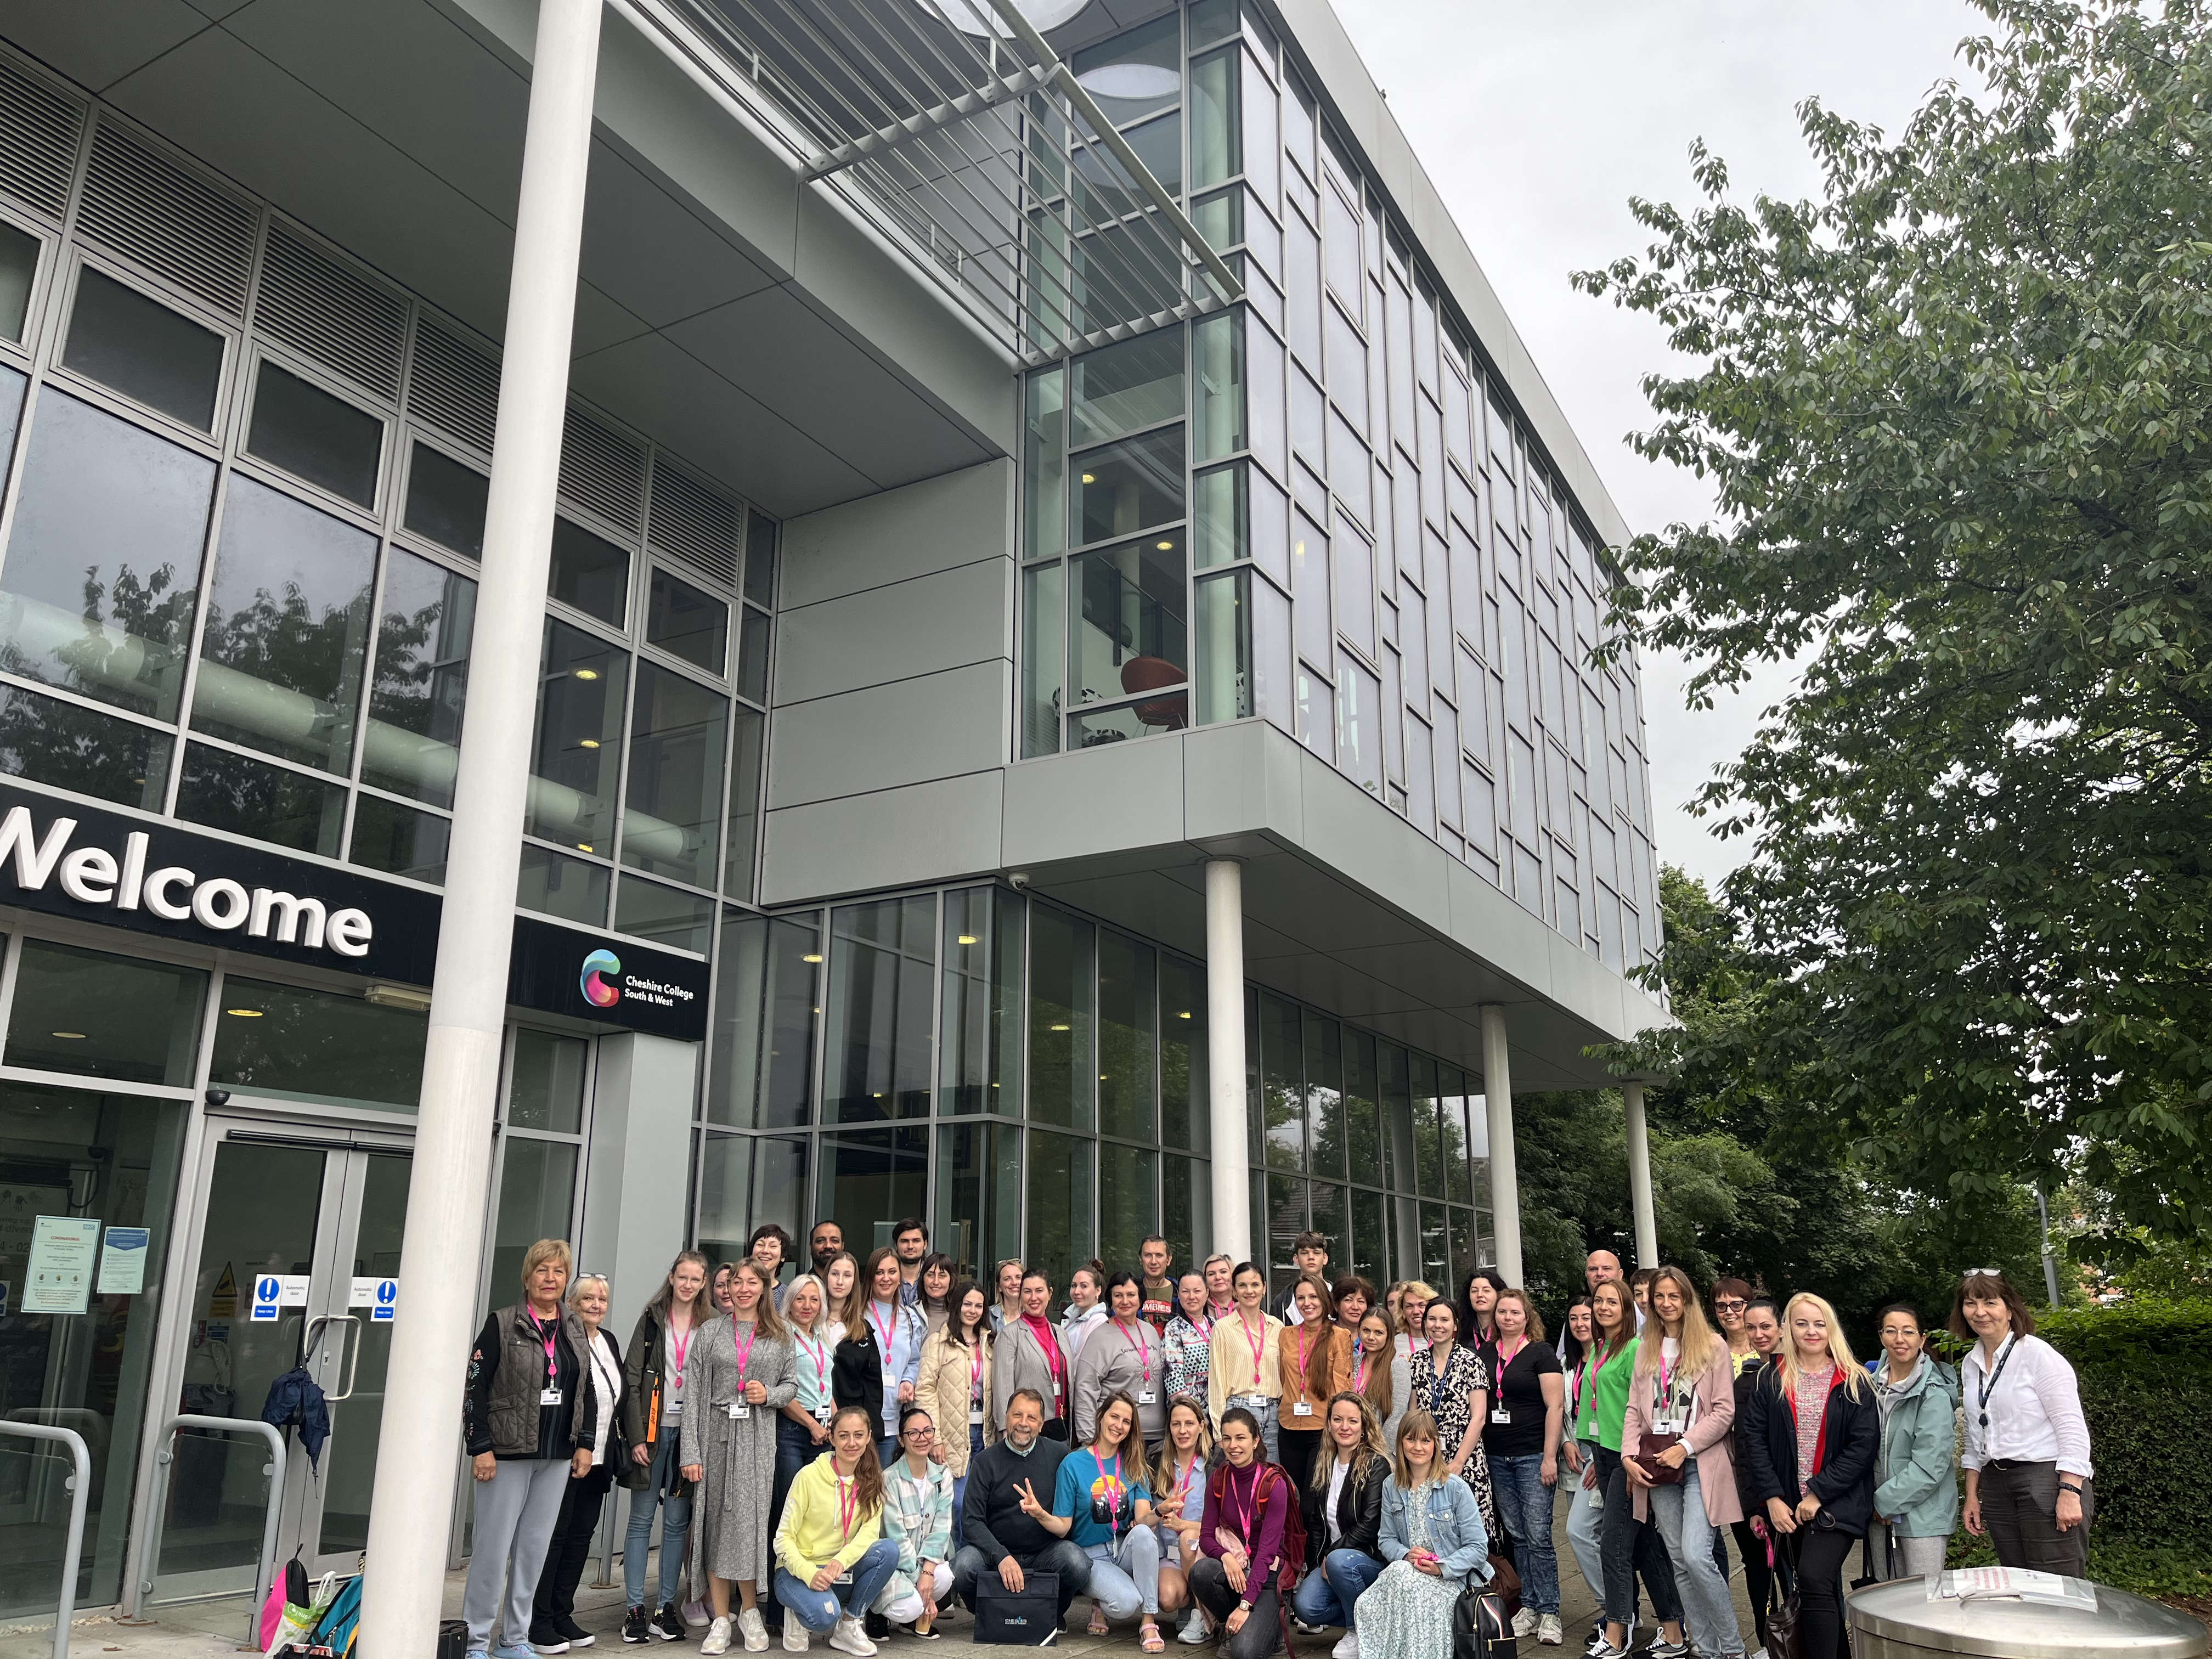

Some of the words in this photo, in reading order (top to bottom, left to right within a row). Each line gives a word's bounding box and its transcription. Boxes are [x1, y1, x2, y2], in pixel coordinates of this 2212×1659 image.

[0, 806, 372, 956] Welcome
[625, 975, 662, 992] Cheshire
[664, 984, 693, 1000] College
[625, 988, 646, 1001] South
[648, 993, 653, 1002] &
[654, 995, 673, 1006] West
